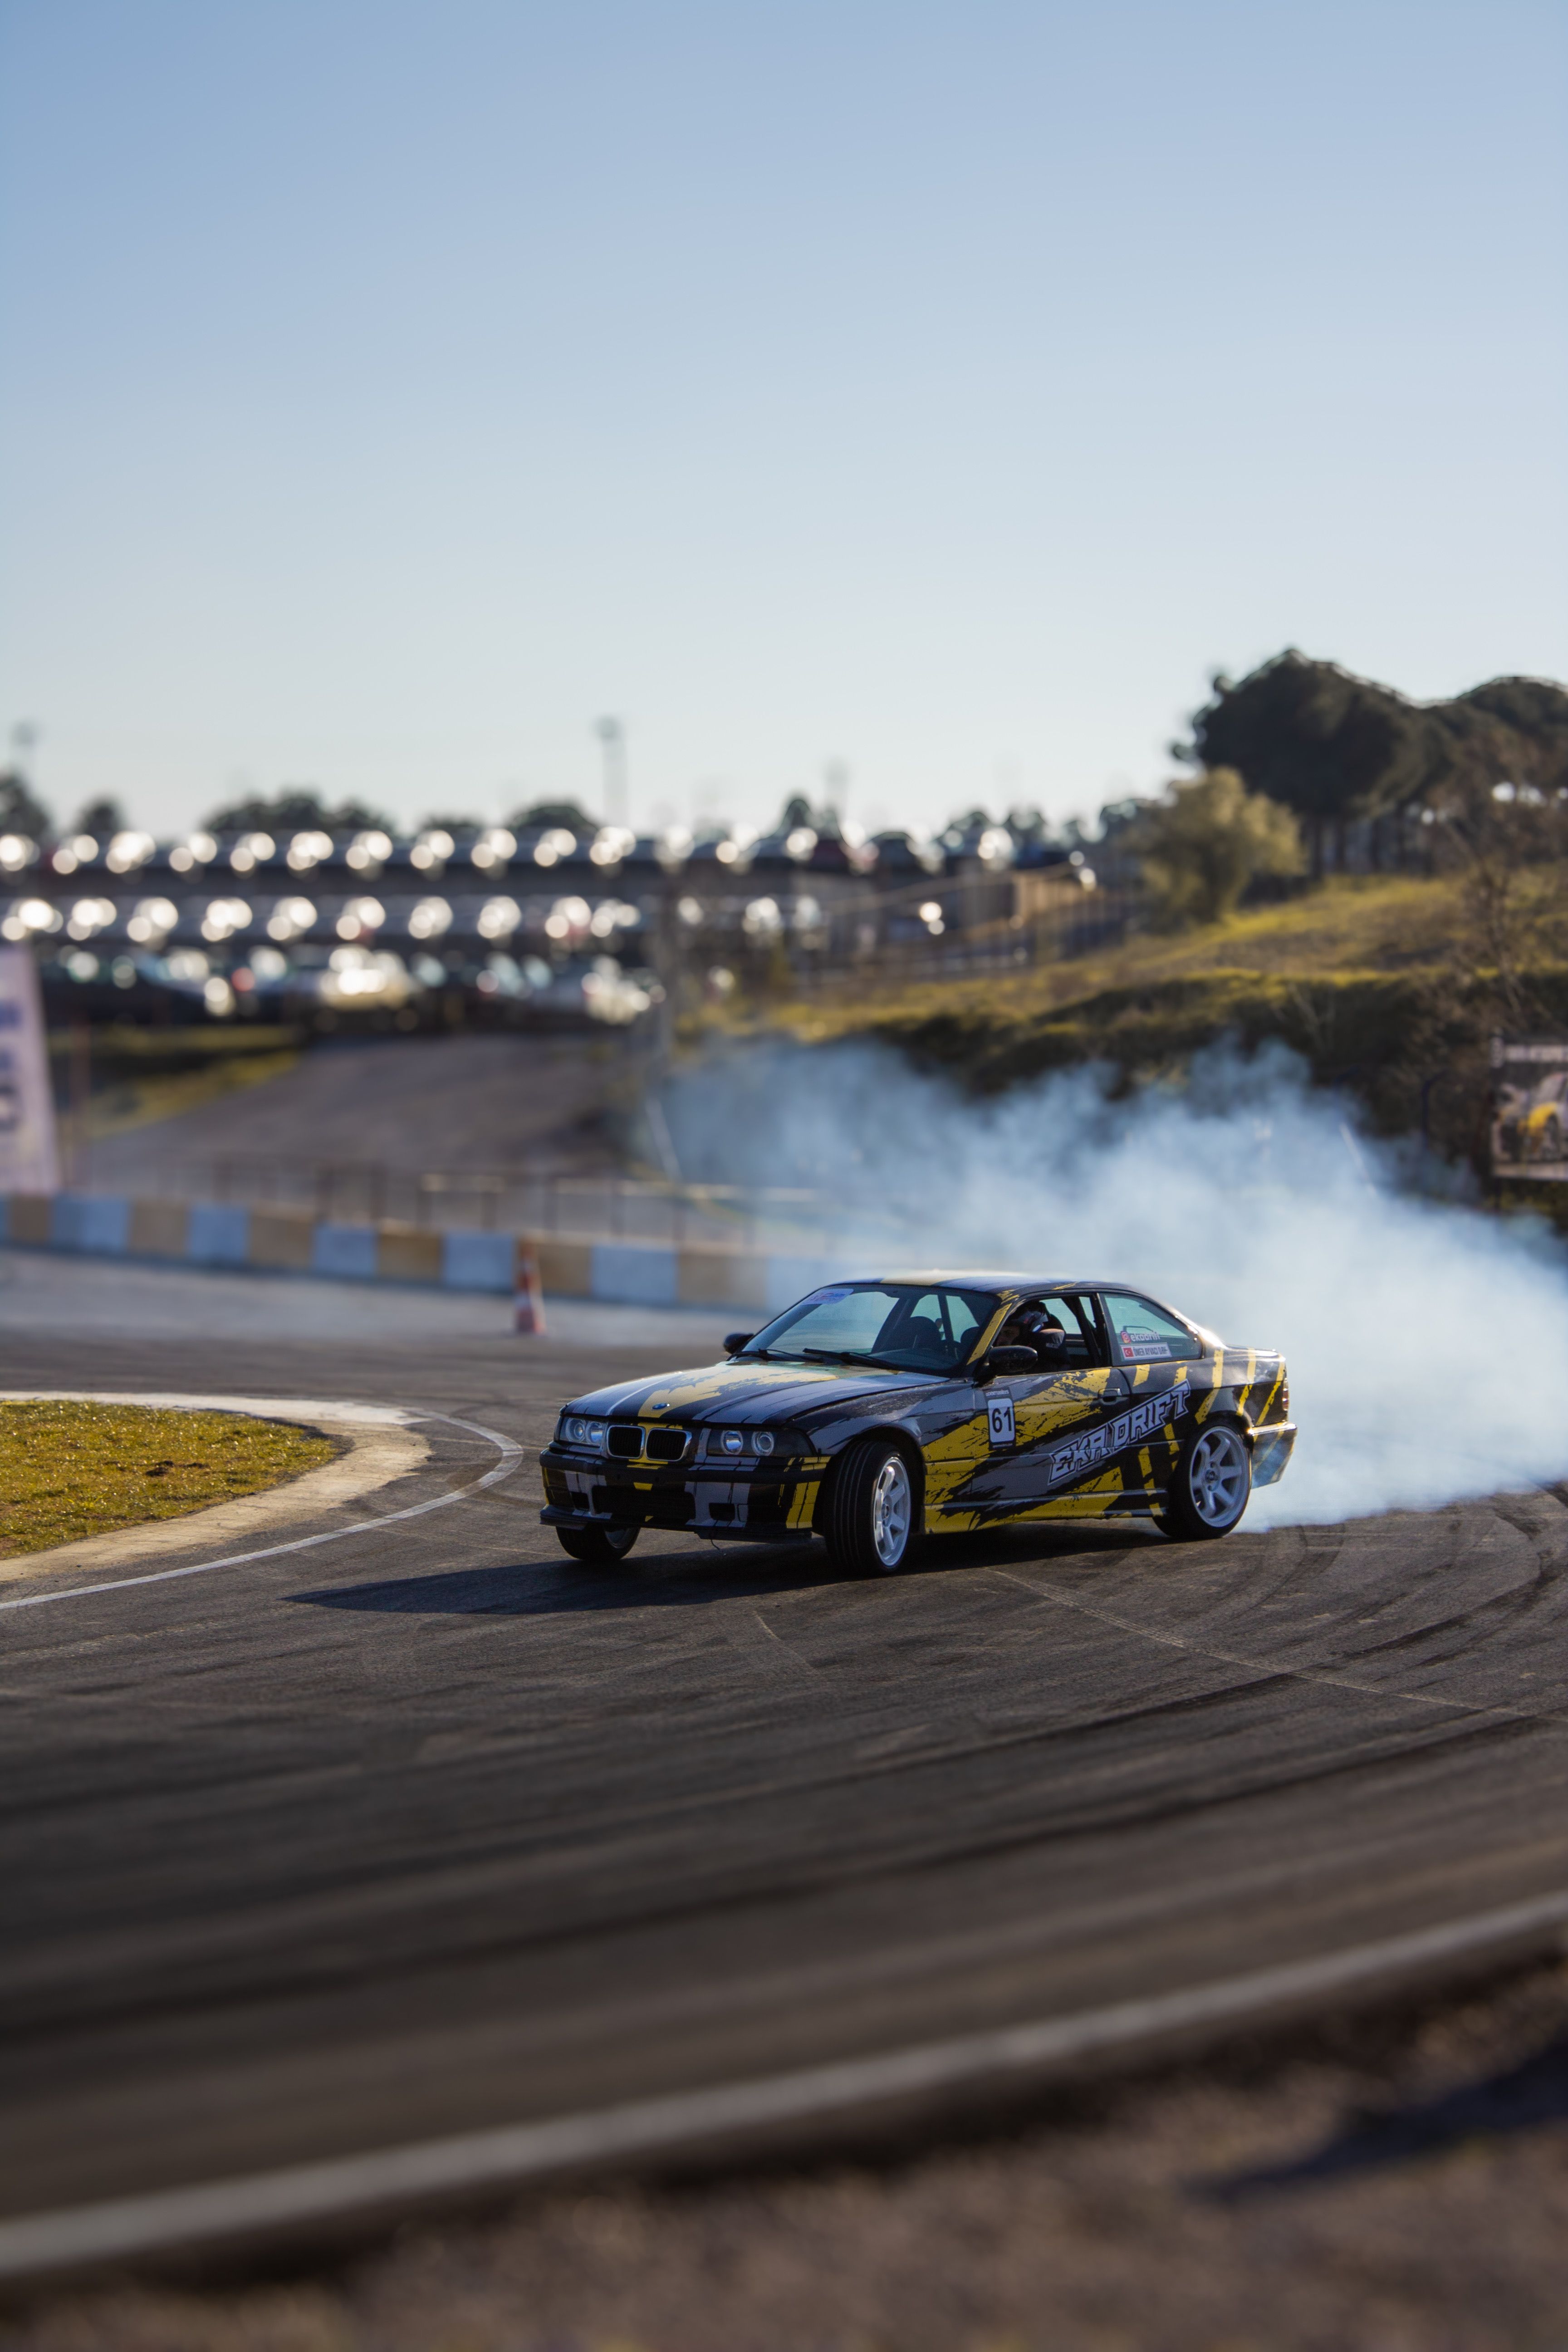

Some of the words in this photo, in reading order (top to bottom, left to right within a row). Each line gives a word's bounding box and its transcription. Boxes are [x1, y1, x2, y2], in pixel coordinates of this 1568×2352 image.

[992, 1407, 1012, 1433] 61
[1049, 1425, 1112, 1483] EKA
[1112, 1381, 1190, 1447] DRIFT
